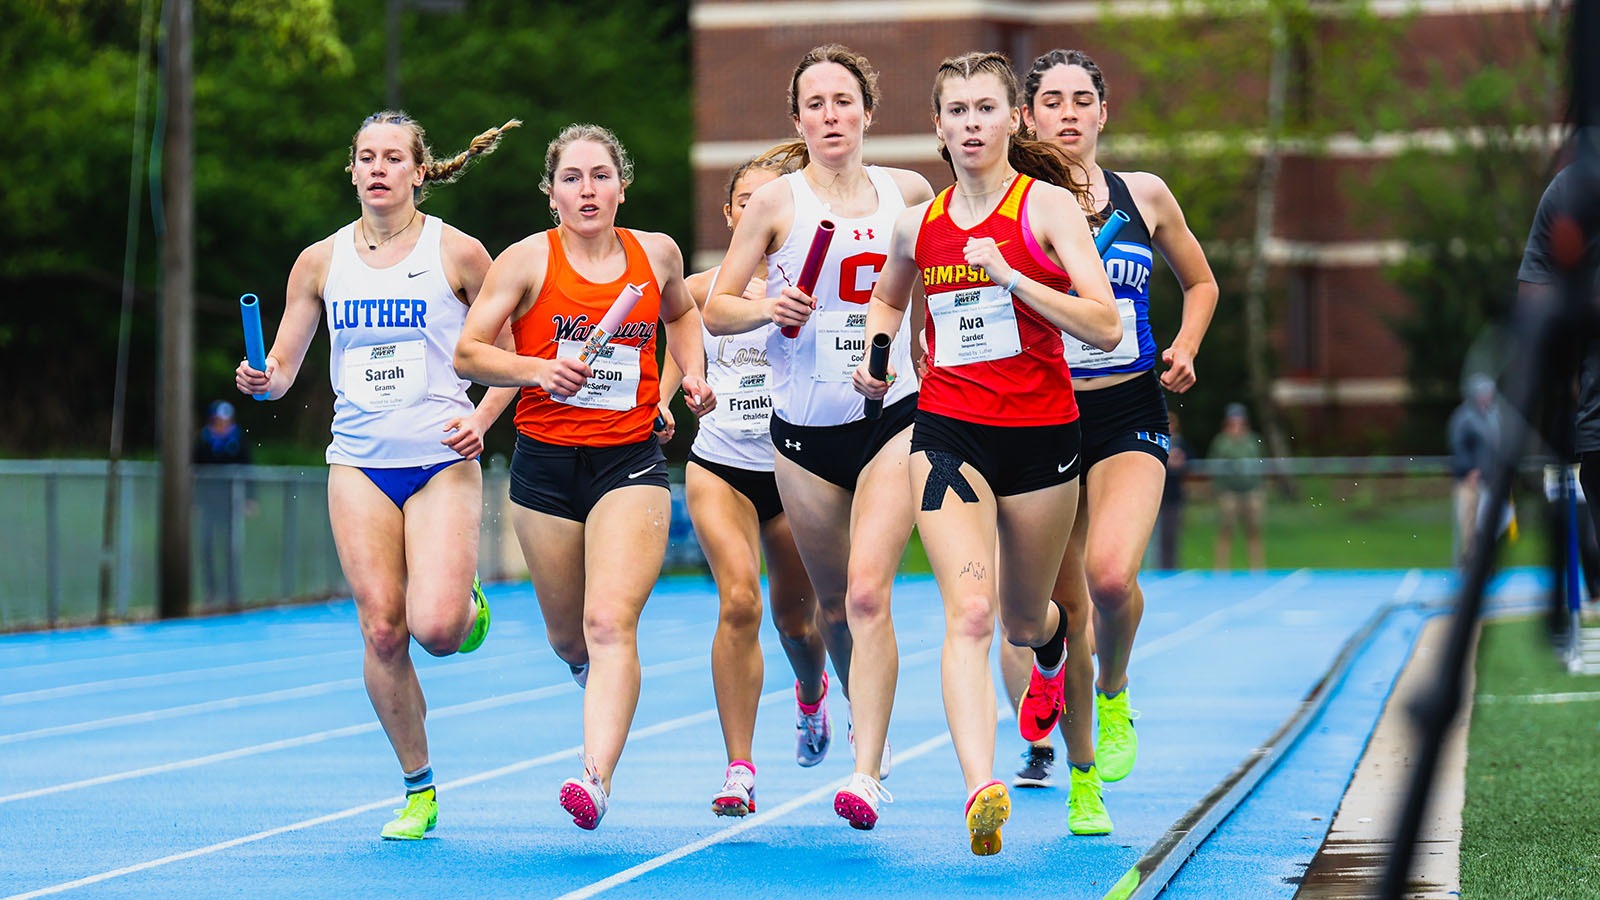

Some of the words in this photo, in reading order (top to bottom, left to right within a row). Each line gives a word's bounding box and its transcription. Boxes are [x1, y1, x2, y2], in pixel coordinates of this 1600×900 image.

[839, 252, 887, 305] C
[924, 264, 990, 286] SIMPSO
[1101, 258, 1151, 294] QUE
[332, 299, 427, 330] LUTHER
[959, 316, 985, 331] Ava
[552, 315, 656, 349] Warurg
[961, 334, 985, 342] Carder
[716, 335, 772, 367] Lora
[835, 336, 866, 351] Laur
[365, 366, 405, 382] Sarah
[592, 368, 623, 382] rson
[729, 395, 773, 411] Franki
